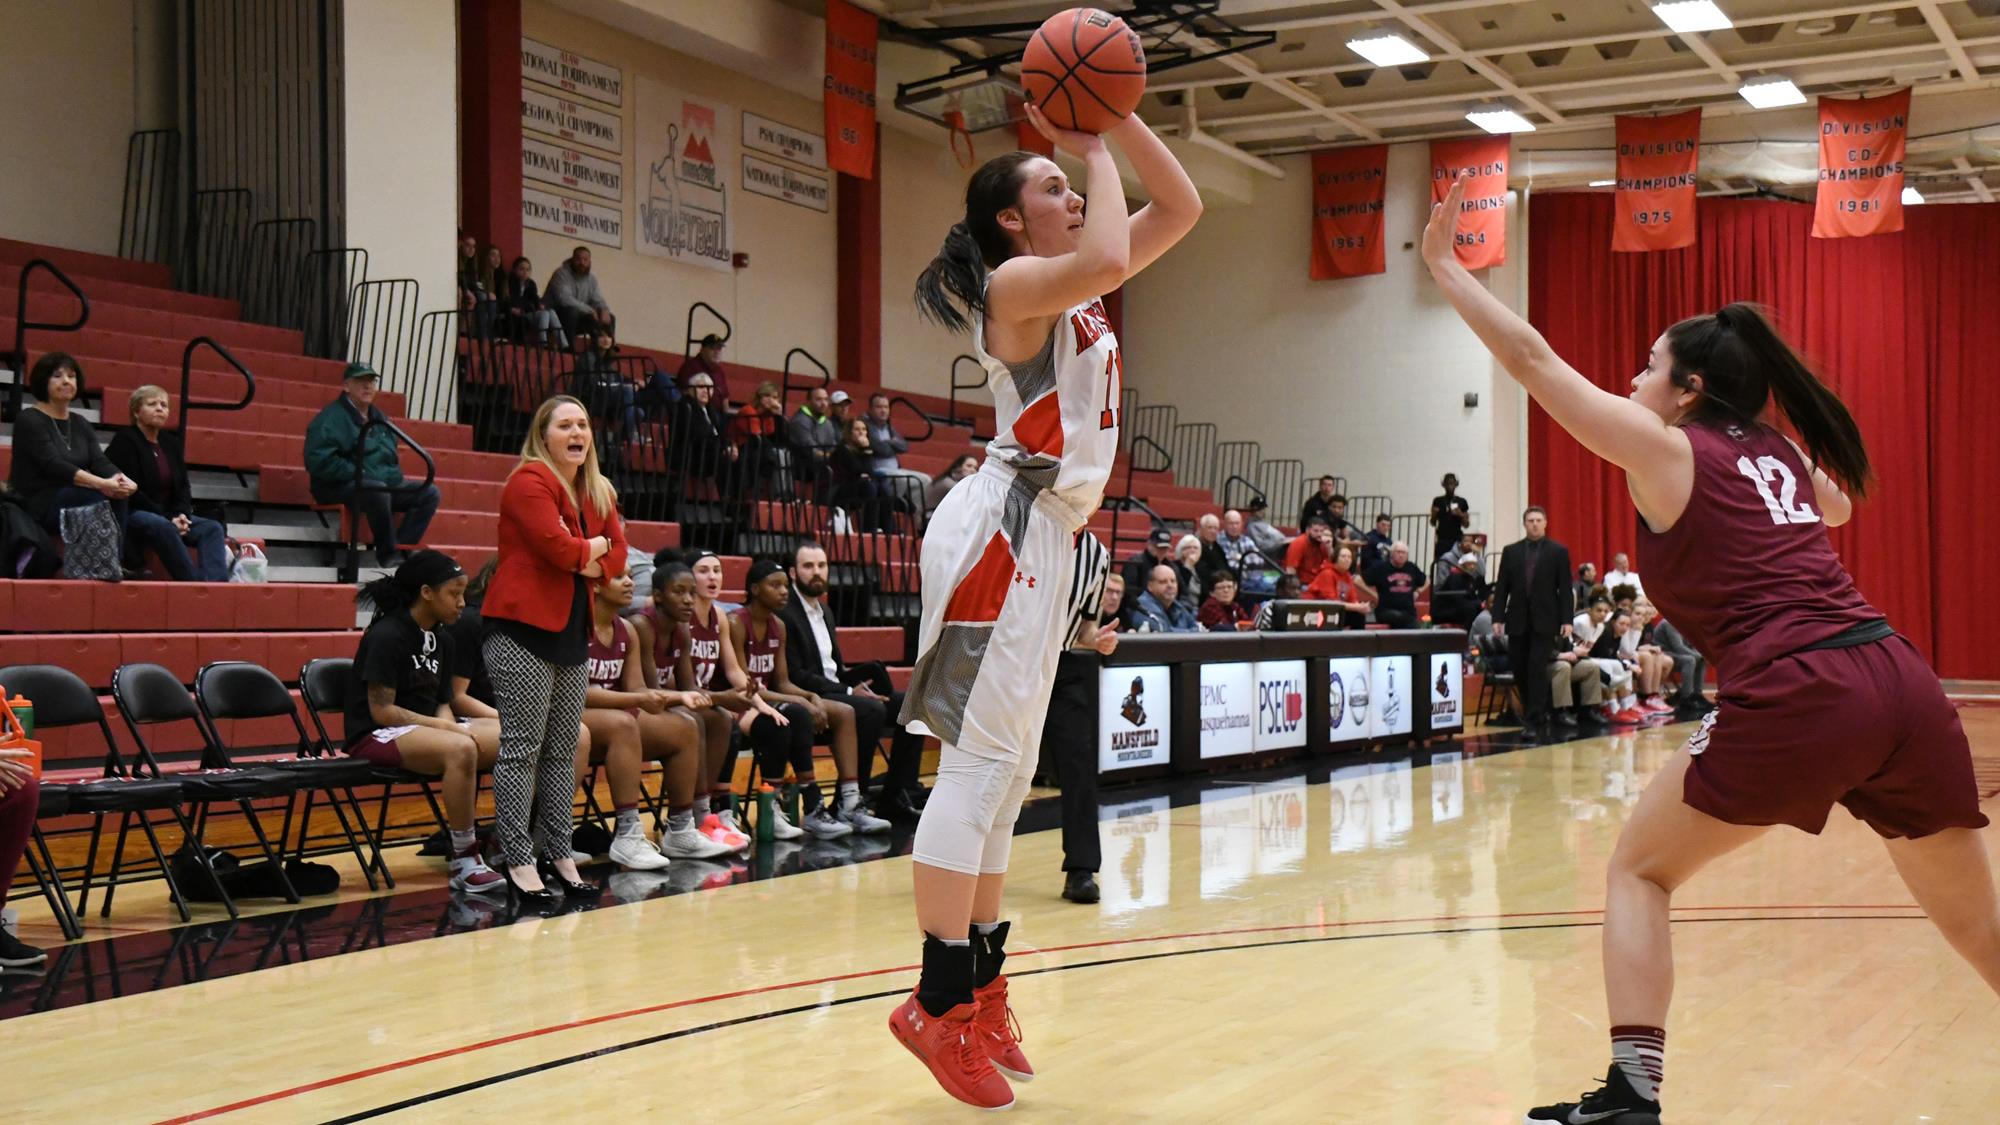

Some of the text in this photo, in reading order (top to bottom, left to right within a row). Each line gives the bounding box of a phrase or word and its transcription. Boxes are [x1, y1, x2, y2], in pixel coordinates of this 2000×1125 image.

[521, 52, 619, 95] ATIONAL TOURNAMENT
[521, 101, 614, 140] EGIONAL CHAMPIONS
[1822, 115, 1905, 135] DIVISION
[1620, 138, 1695, 156] DIVISION
[1848, 149, 1879, 162] CO-
[522, 149, 619, 190] ATIONAL TOURNAMENT
[1435, 161, 1504, 180] DIVSION
[1820, 162, 1904, 181] CHAMPIONS
[1616, 173, 1697, 191] CHAMPIONS
[1839, 200, 1880, 213] 1981
[522, 200, 619, 236] ATIONAL TOURNAMENT
[1634, 211, 1673, 225] 1975
[640, 203, 730, 262] VOLLEYBALL
[1455, 232, 1486, 246] 964
[1736, 455, 1820, 525] 12
[1259, 680, 1298, 735] PSECU
[1200, 708, 1250, 736] usquehanna
[1111, 729, 1159, 751] MANSFIELD
